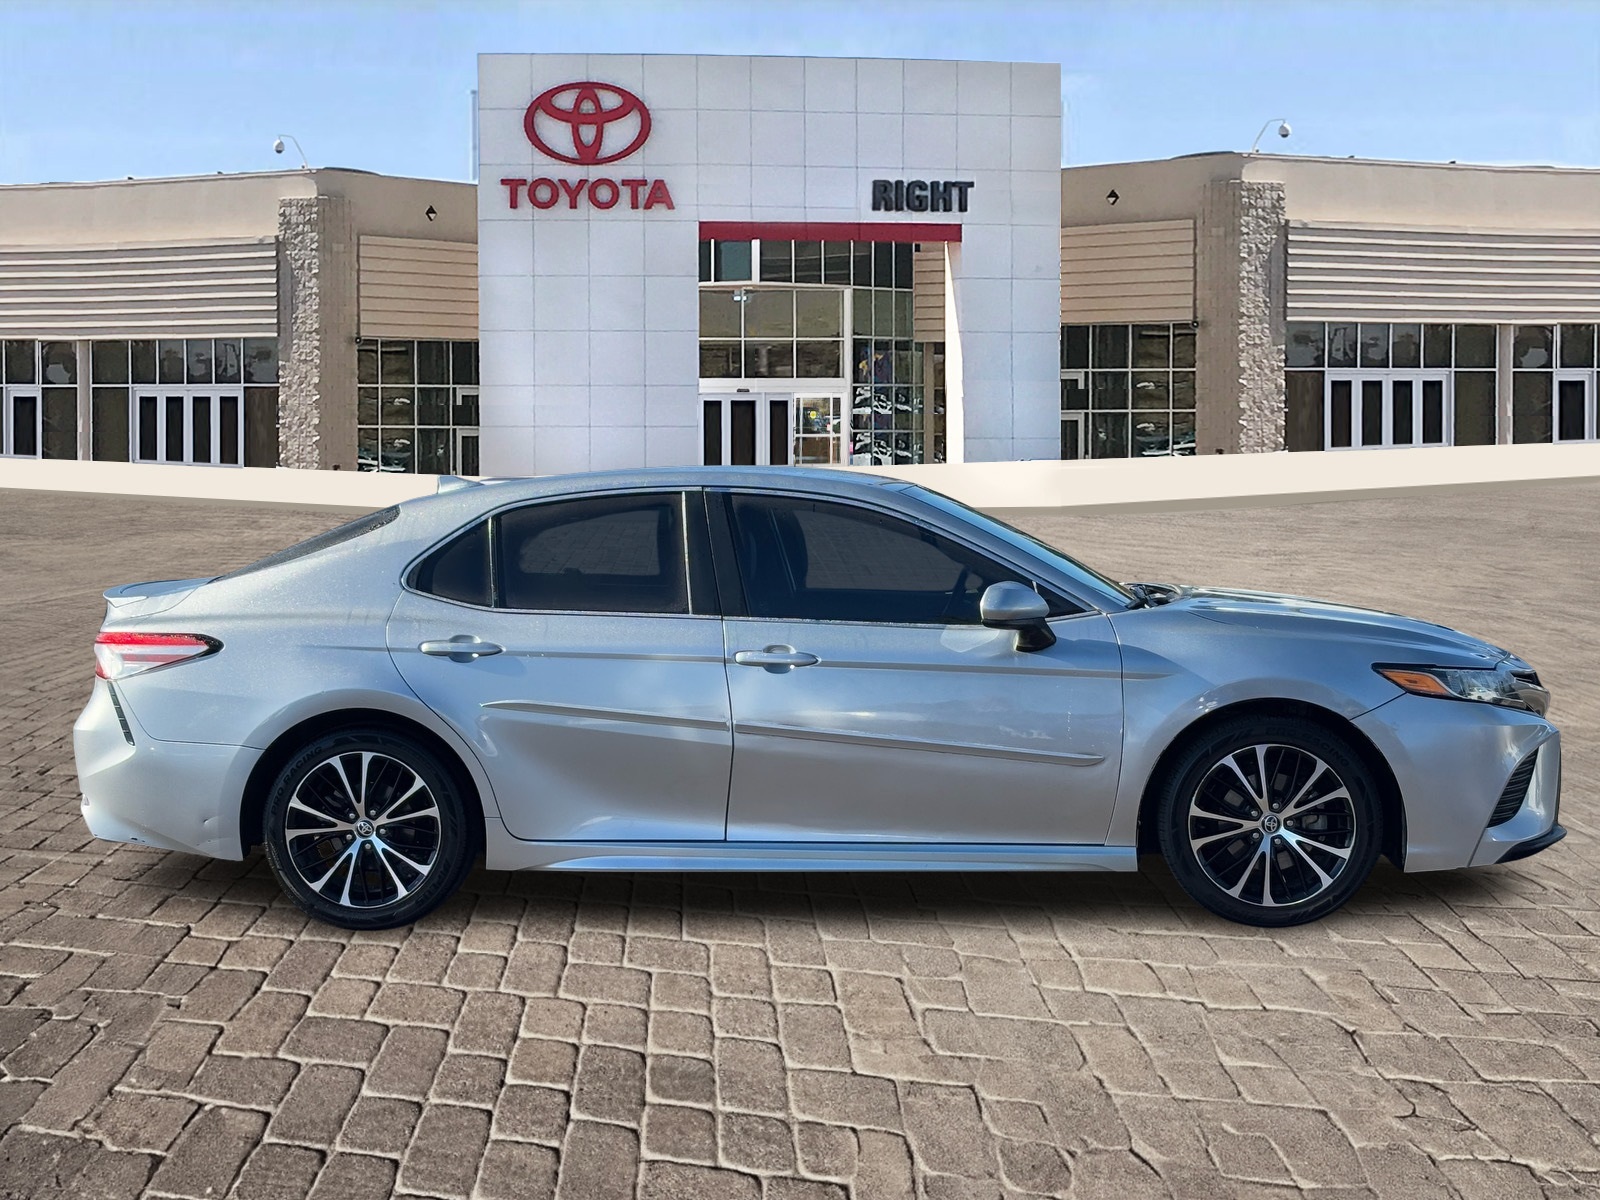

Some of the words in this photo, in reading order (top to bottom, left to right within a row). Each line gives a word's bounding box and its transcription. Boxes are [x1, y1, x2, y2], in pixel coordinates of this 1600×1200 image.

[500, 177, 675, 210] TOYOTA
[872, 179, 975, 212] RIGHT
[270, 786, 284, 816] PRO
[282, 746, 322, 785] RACING
